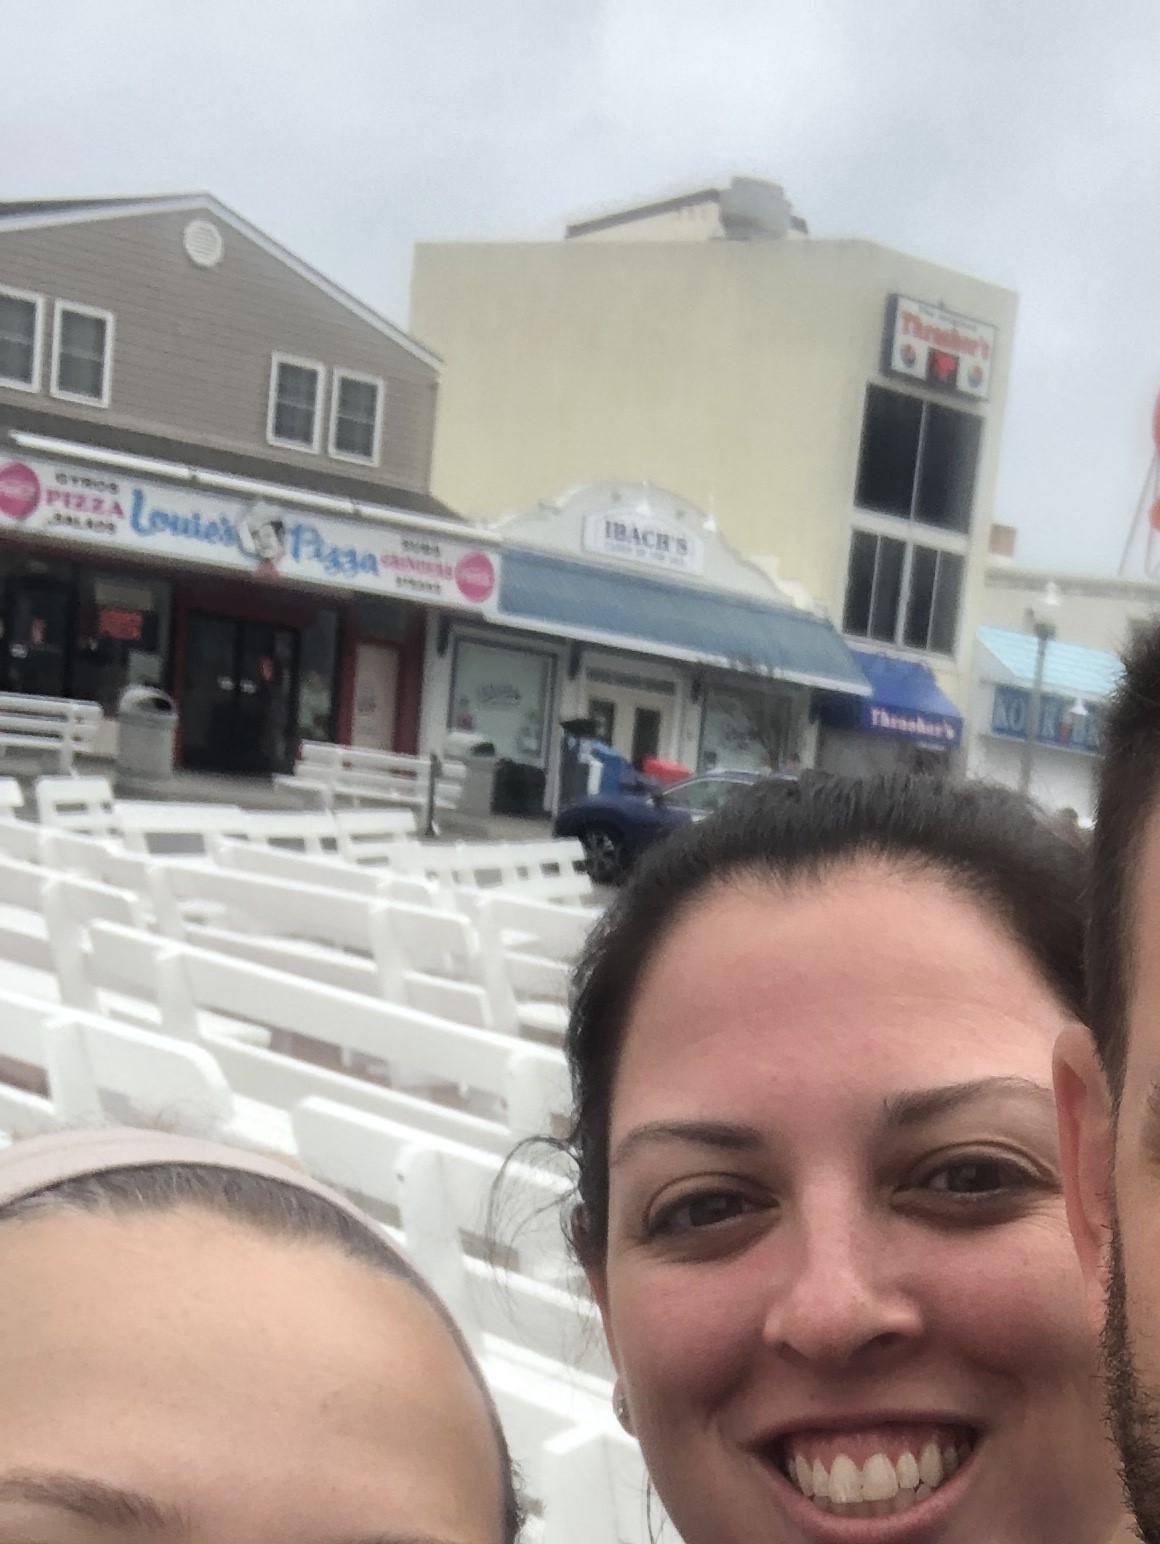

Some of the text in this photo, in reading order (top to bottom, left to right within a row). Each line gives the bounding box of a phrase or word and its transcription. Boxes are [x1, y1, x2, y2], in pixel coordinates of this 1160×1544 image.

[46, 488, 125, 519] PIZZA
[130, 487, 380, 577] Louie's Pizza
[604, 520, 689, 556] IBACH'S
